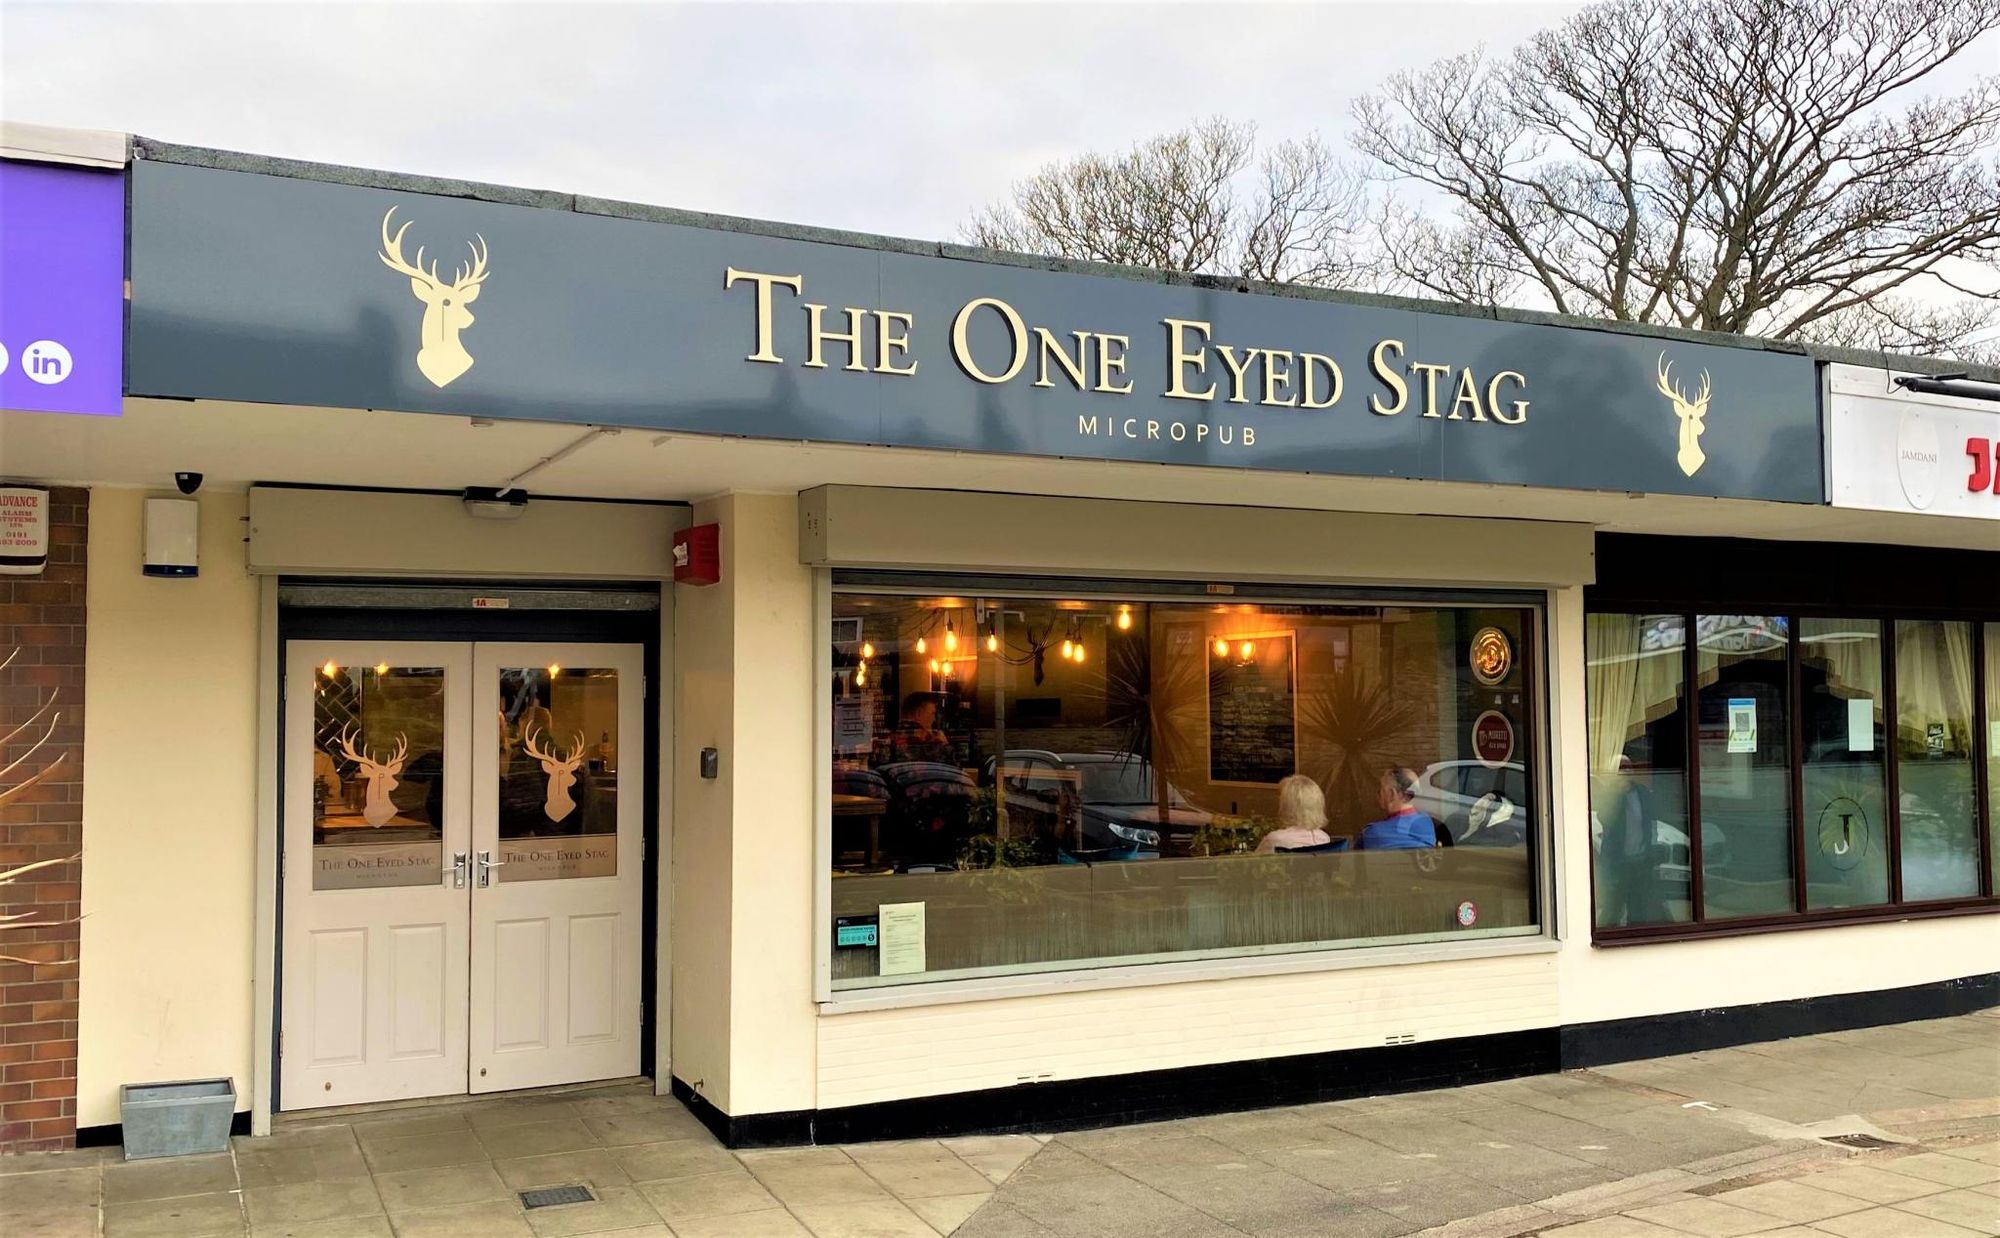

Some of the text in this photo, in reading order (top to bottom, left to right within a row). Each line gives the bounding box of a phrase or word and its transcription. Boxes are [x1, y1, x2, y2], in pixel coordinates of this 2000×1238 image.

[725, 266, 1530, 425] THE ONE EYED STAG
[1079, 415, 1256, 446] MICROPUB
[1901, 450, 1938, 464] JAMDANI
[1966, 437, 2000, 495] J
